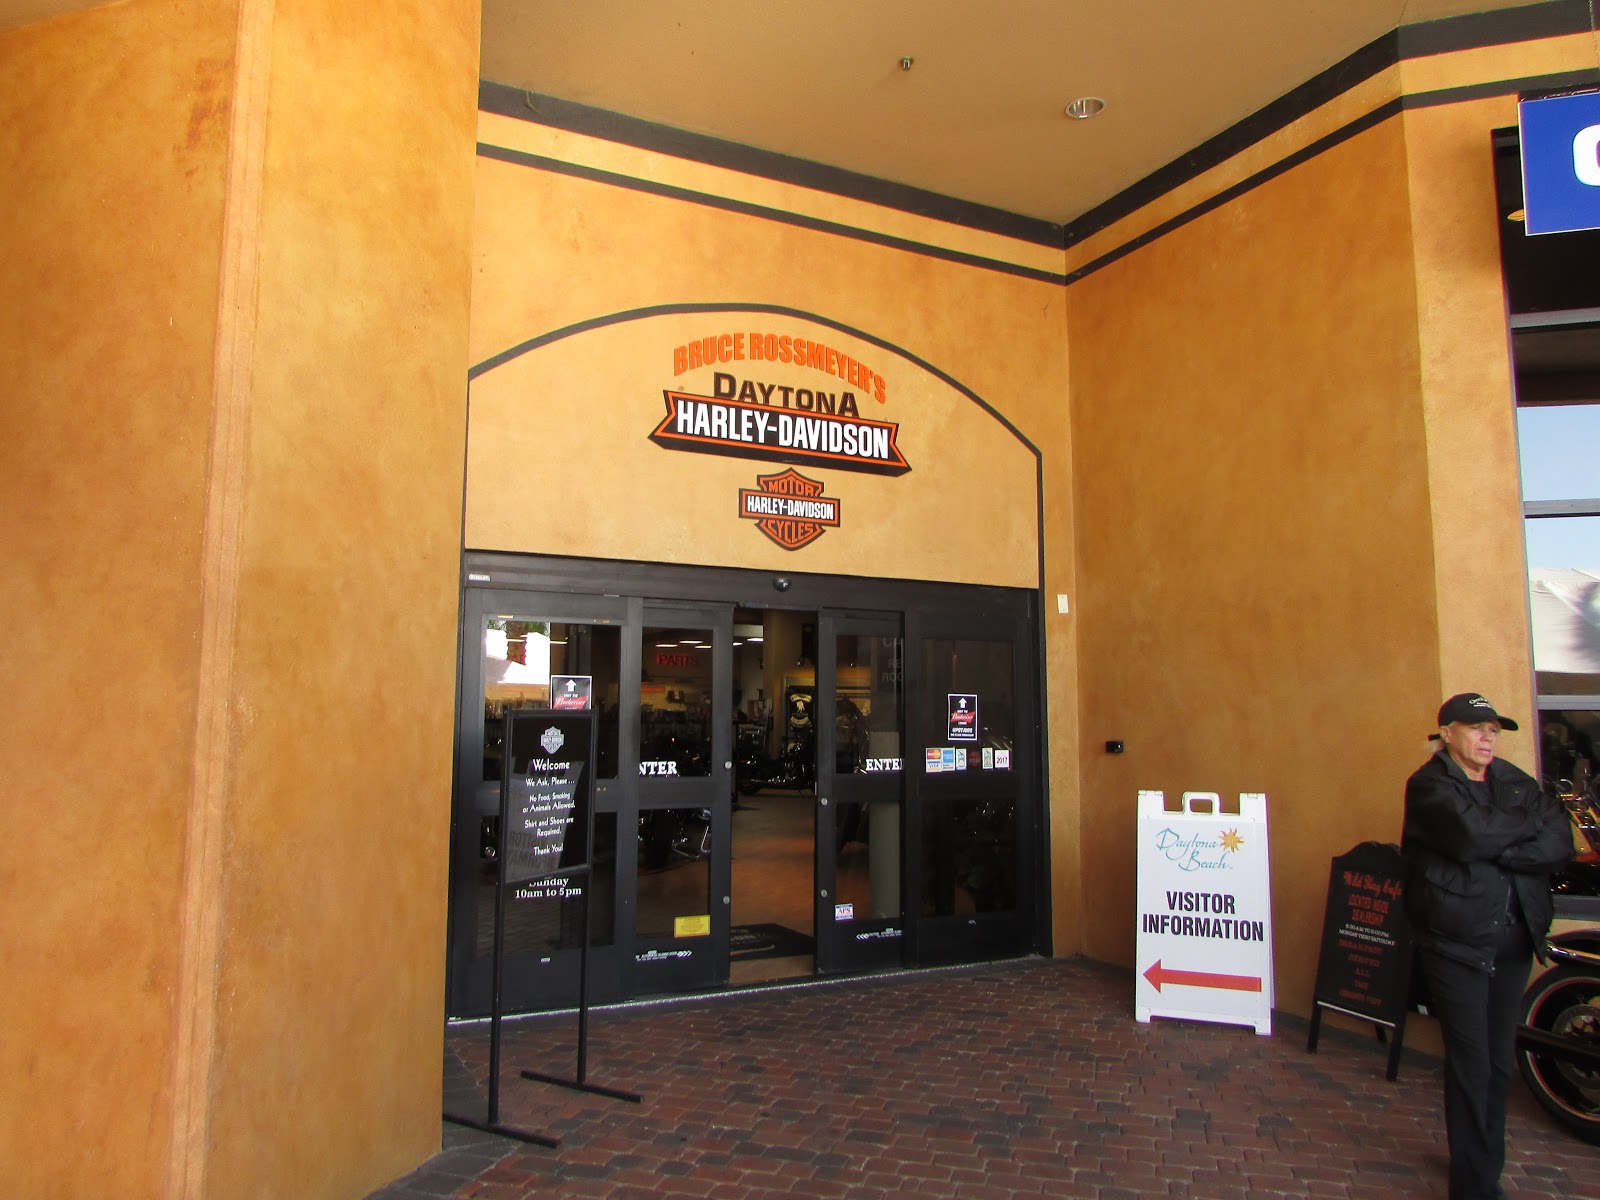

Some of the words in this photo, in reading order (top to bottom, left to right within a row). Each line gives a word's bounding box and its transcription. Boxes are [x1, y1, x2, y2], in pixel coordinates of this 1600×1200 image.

[674, 333, 745, 377] BRUCE
[750, 333, 887, 405] ROSSMEYER'S
[714, 371, 860, 418] DAYTONA
[677, 400, 889, 460] HARLEY-DAVIDSON
[768, 478, 815, 497] MOTOR
[747, 495, 834, 520] HARLEY-DAVIDSON
[767, 519, 814, 544] CYCLES
[532, 757, 571, 771] Welcome
[639, 761, 678, 775] NTER
[865, 758, 903, 771] ENTE
[996, 756, 1008, 764] 2017
[525, 777, 536, 787] We
[536, 776, 550, 787] Ask,
[529, 793, 538, 802] No
[552, 791, 571, 801] Smoking
[529, 802, 551, 812] Animals
[524, 819, 538, 829] Shirt
[538, 817, 549, 827] and
[549, 816, 565, 826] Shoes
[533, 844, 550, 856] Thank
[551, 842, 564, 854] You!
[1155, 827, 1219, 860] Daytona
[1178, 850, 1229, 872] Beach
[515, 889, 543, 899] 10am
[546, 887, 557, 897] to
[559, 886, 583, 898] 5pm
[1166, 890, 1236, 915] VISITOR
[1142, 913, 1265, 942] INFORMATION
